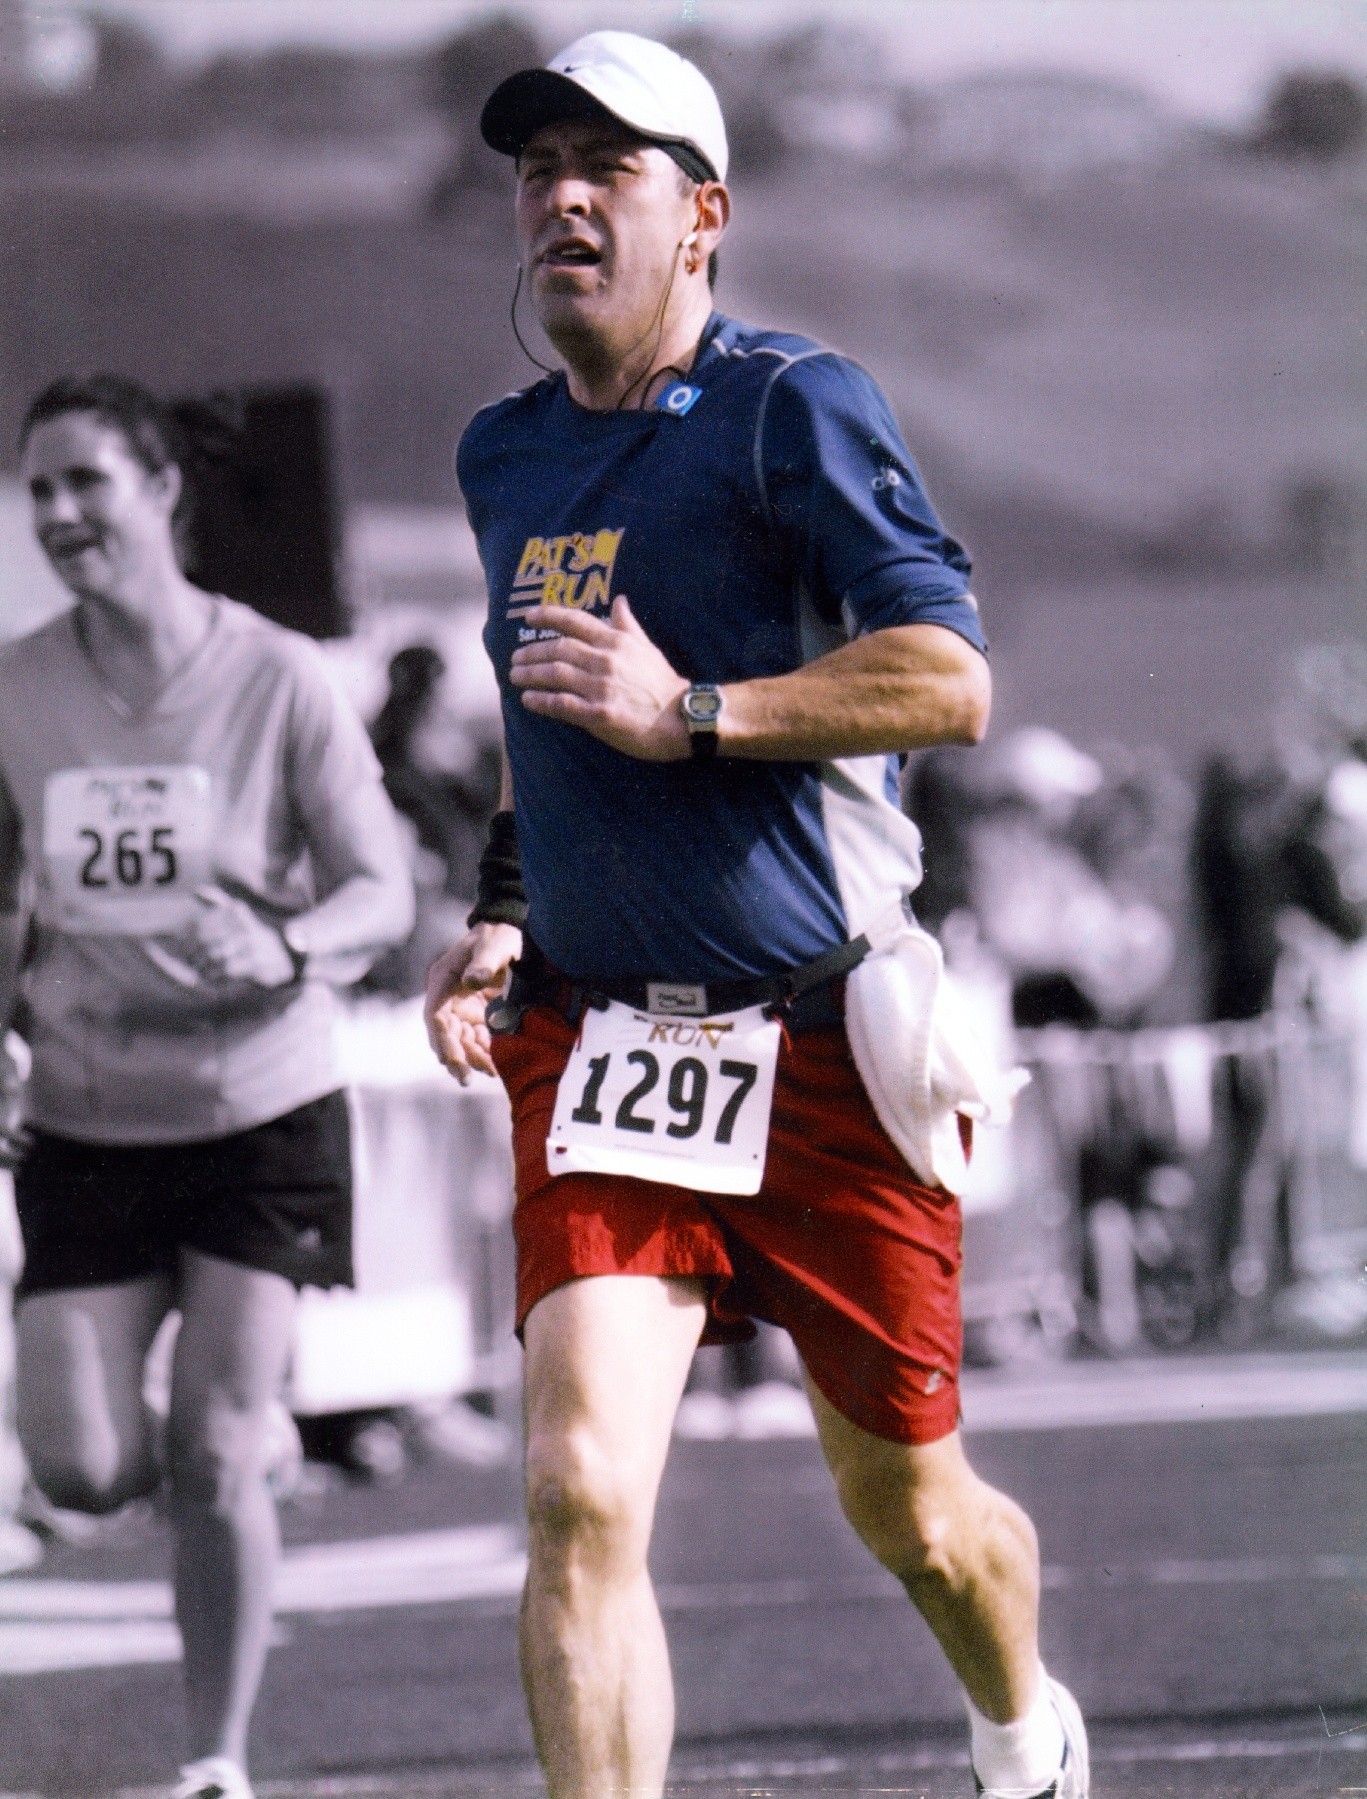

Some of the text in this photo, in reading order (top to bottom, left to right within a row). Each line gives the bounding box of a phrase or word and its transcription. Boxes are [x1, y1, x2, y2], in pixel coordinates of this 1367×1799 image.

[516, 533, 600, 577] PAT'S
[541, 571, 611, 609] RUN
[79, 827, 178, 888] 265
[648, 1022, 726, 1049] RUN
[572, 1049, 758, 1145] 1297
